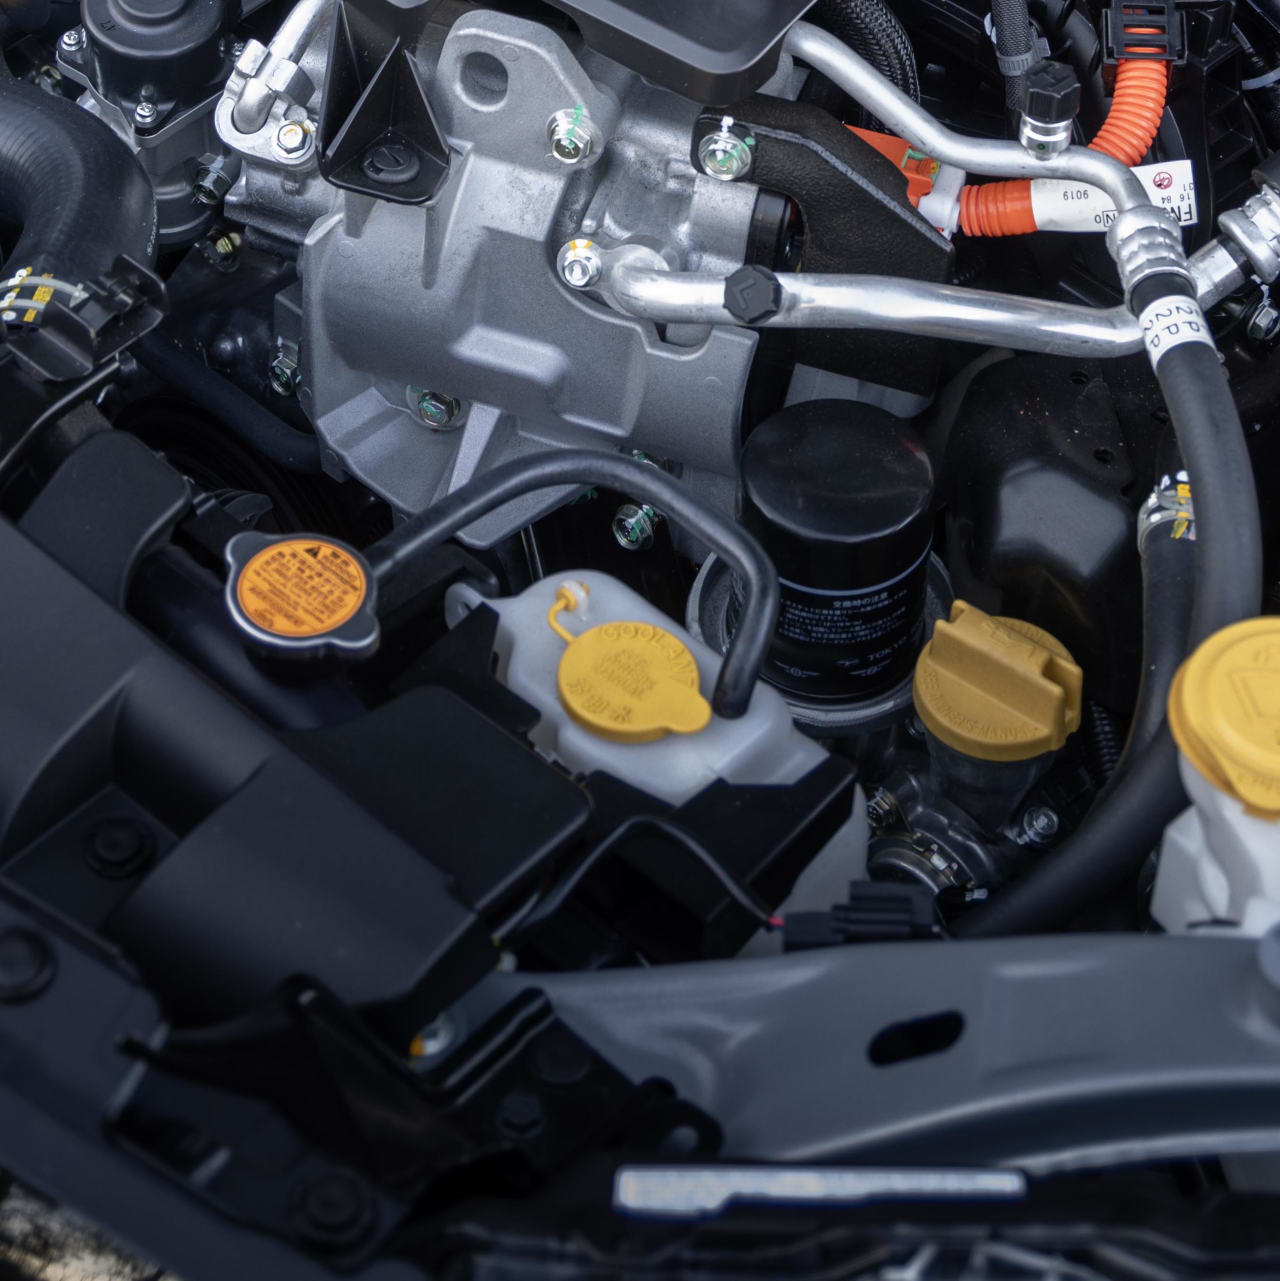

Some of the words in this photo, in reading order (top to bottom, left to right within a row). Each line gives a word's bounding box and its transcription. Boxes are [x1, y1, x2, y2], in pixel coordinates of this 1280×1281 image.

[1061, 186, 1089, 203] 9019
[1159, 193, 1172, 204] 84
[601, 623, 697, 689] COOLANT
